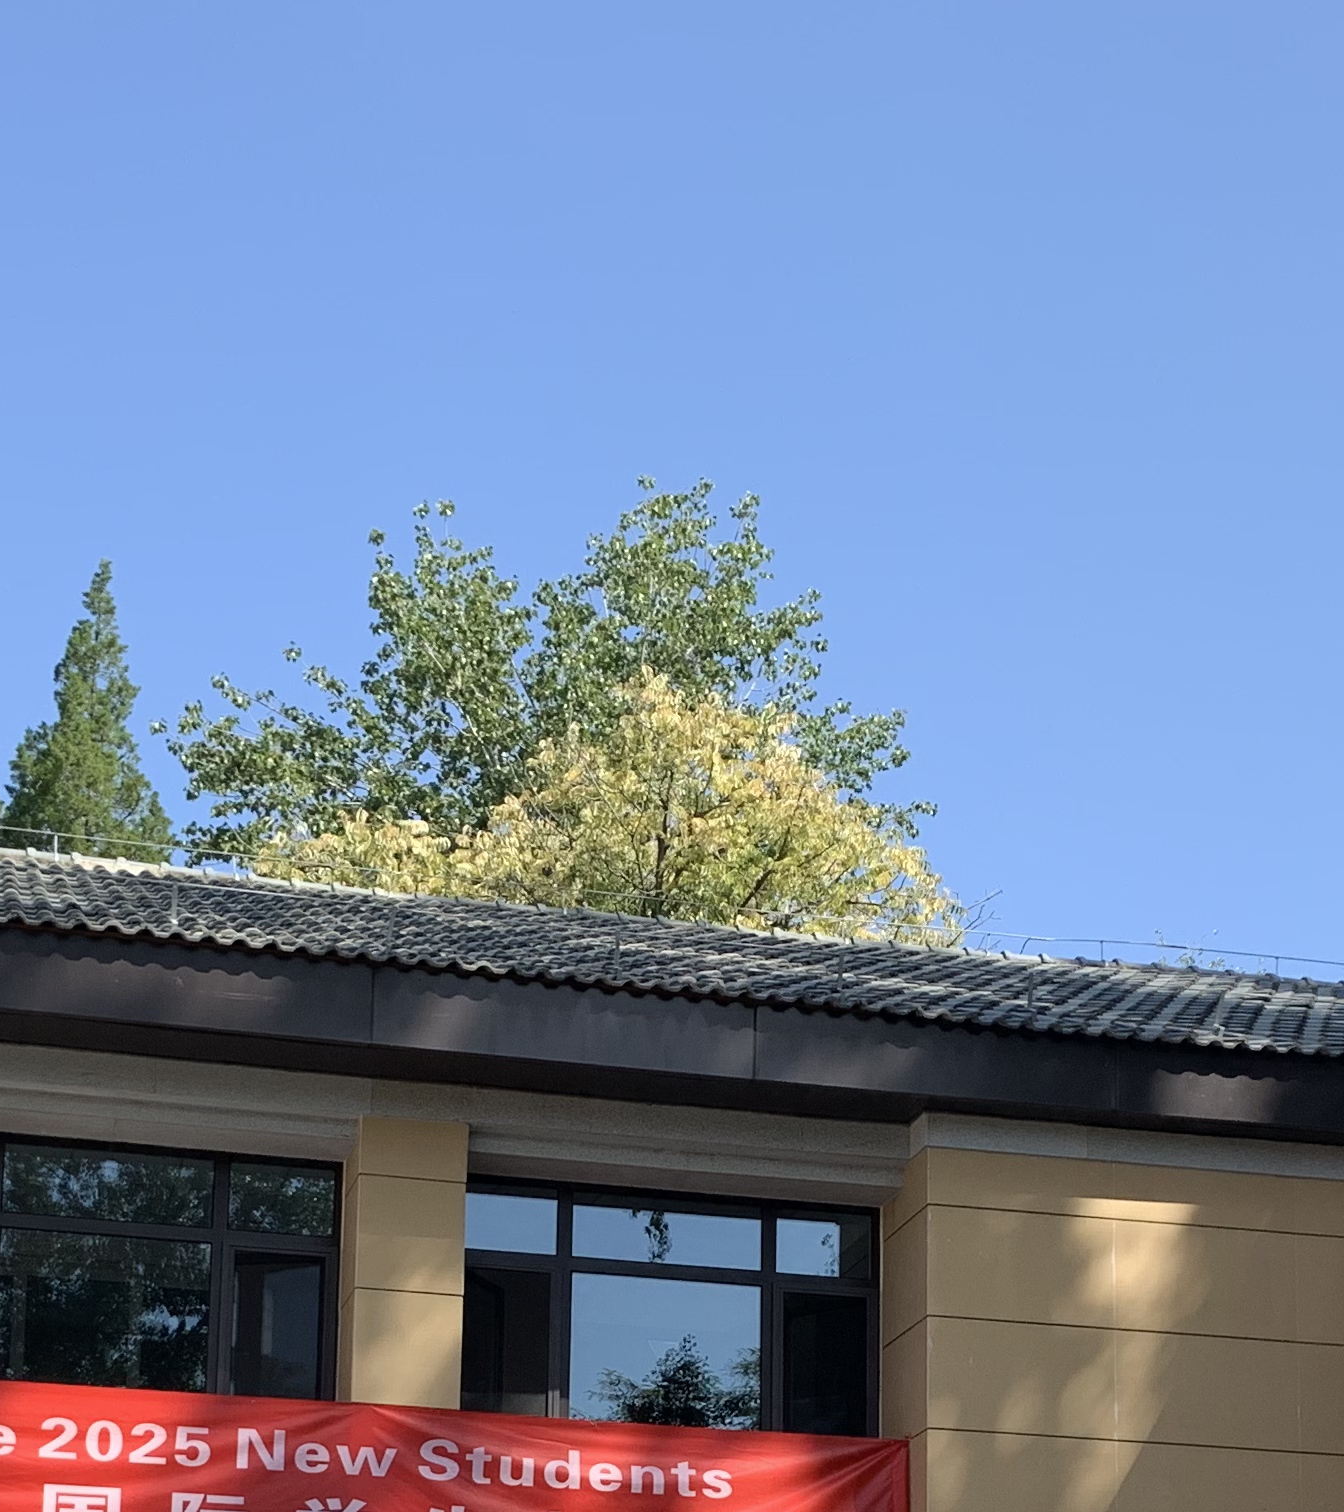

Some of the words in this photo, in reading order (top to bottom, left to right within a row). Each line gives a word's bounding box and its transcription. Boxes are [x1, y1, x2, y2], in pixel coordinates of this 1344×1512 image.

[37, 1416, 212, 1468] 2025
[235, 1428, 398, 1478] New
[416, 1438, 734, 1499] Students
